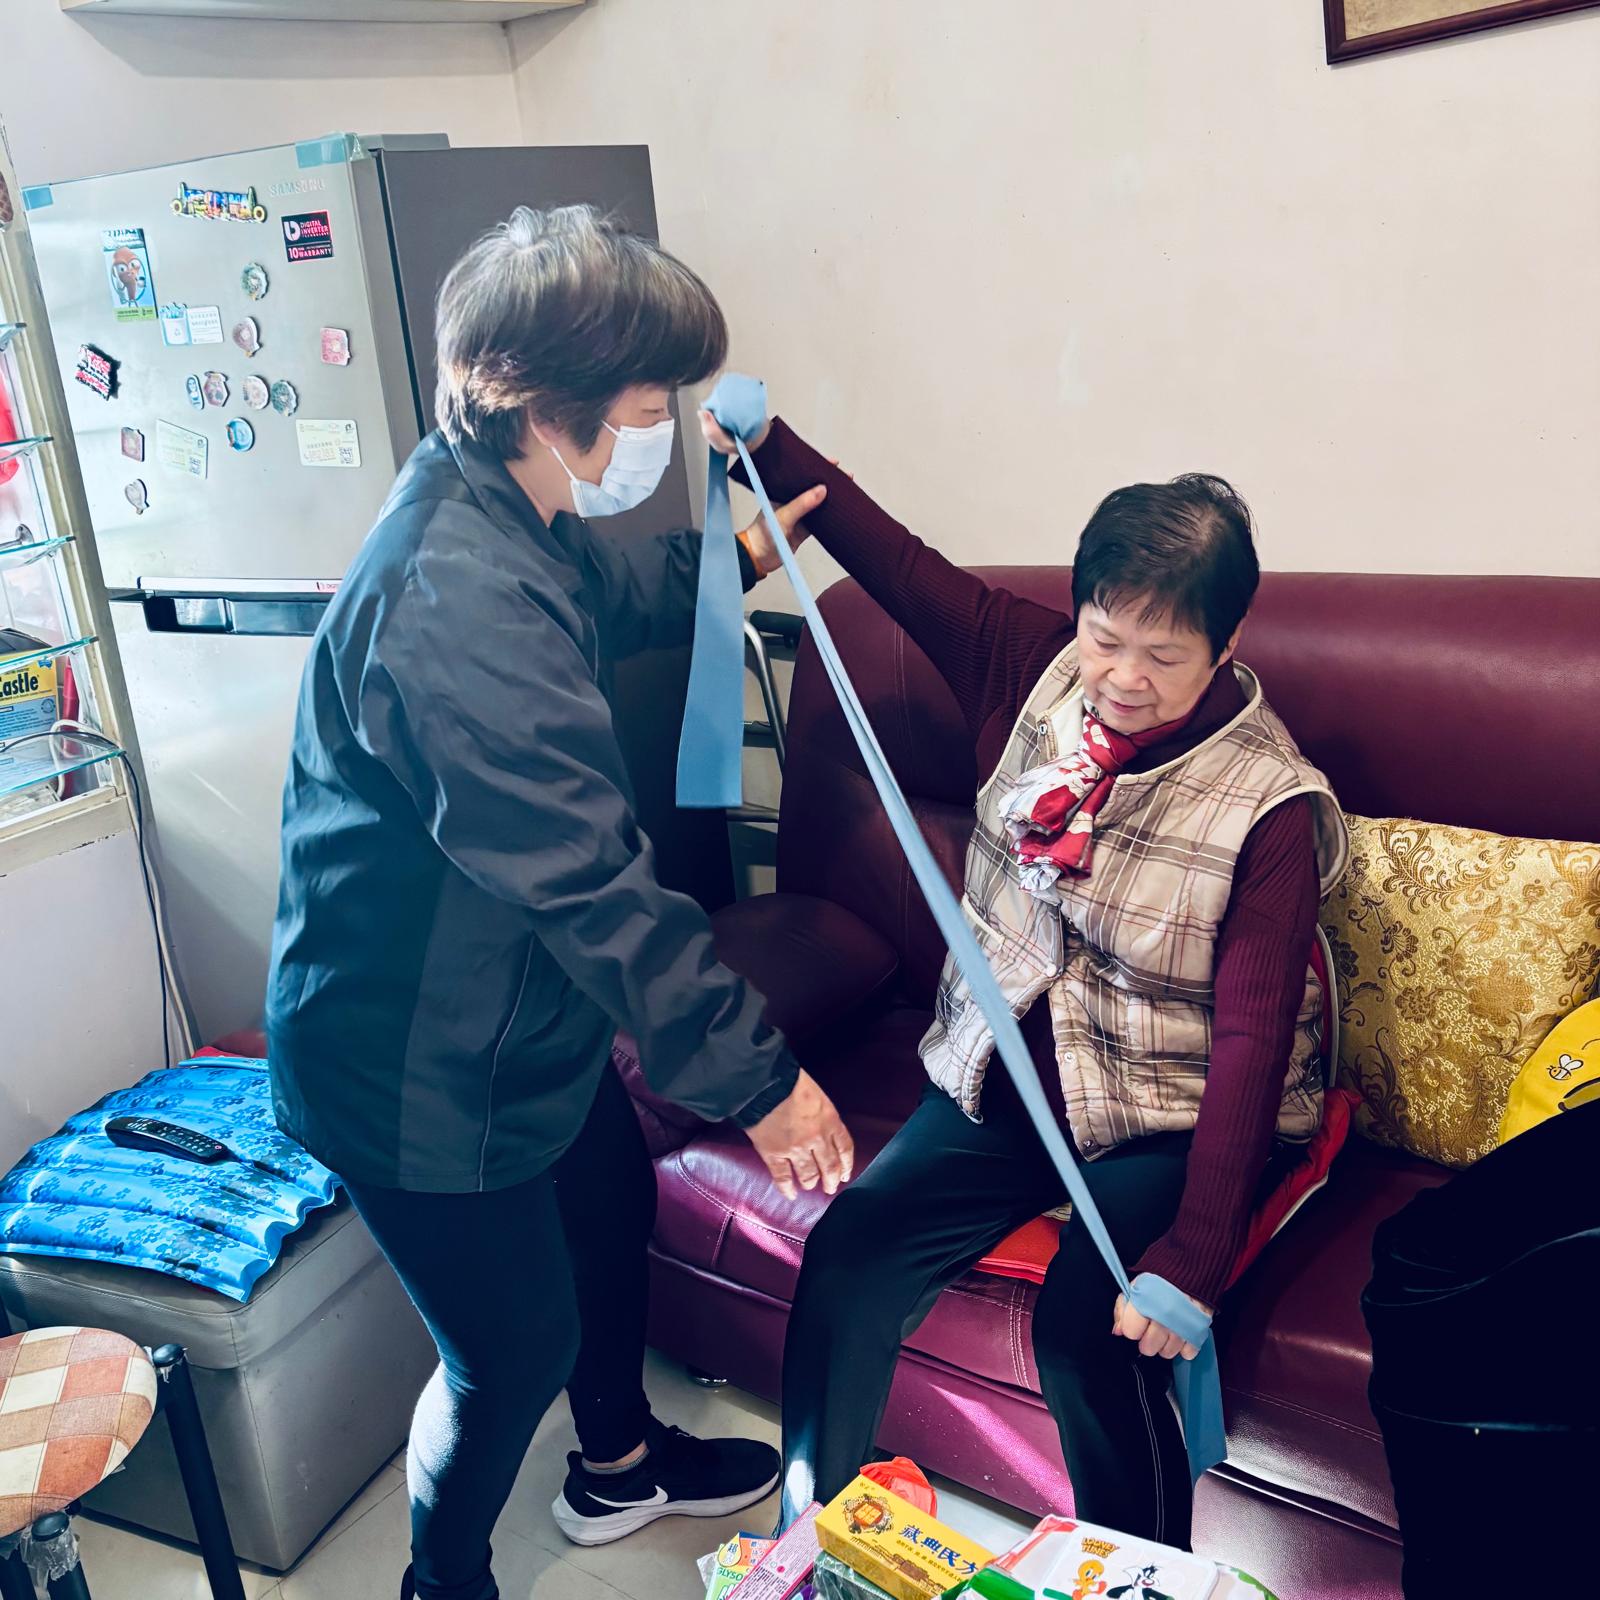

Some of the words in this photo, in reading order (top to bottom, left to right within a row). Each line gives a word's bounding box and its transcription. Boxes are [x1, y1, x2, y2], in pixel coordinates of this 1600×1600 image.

[270, 178, 325, 196] SAMSUNG
[300, 220, 321, 229] DIGITAL
[300, 225, 329, 235] INVERTER
[288, 247, 299, 259] 10
[299, 247, 332, 258] WARRANTY
[0, 671, 39, 697] astle
[899, 1524, 979, 1575] 藏典民方
[1081, 1537, 1120, 1552] LOONEY
[1081, 1543, 1109, 1558] TUNES
